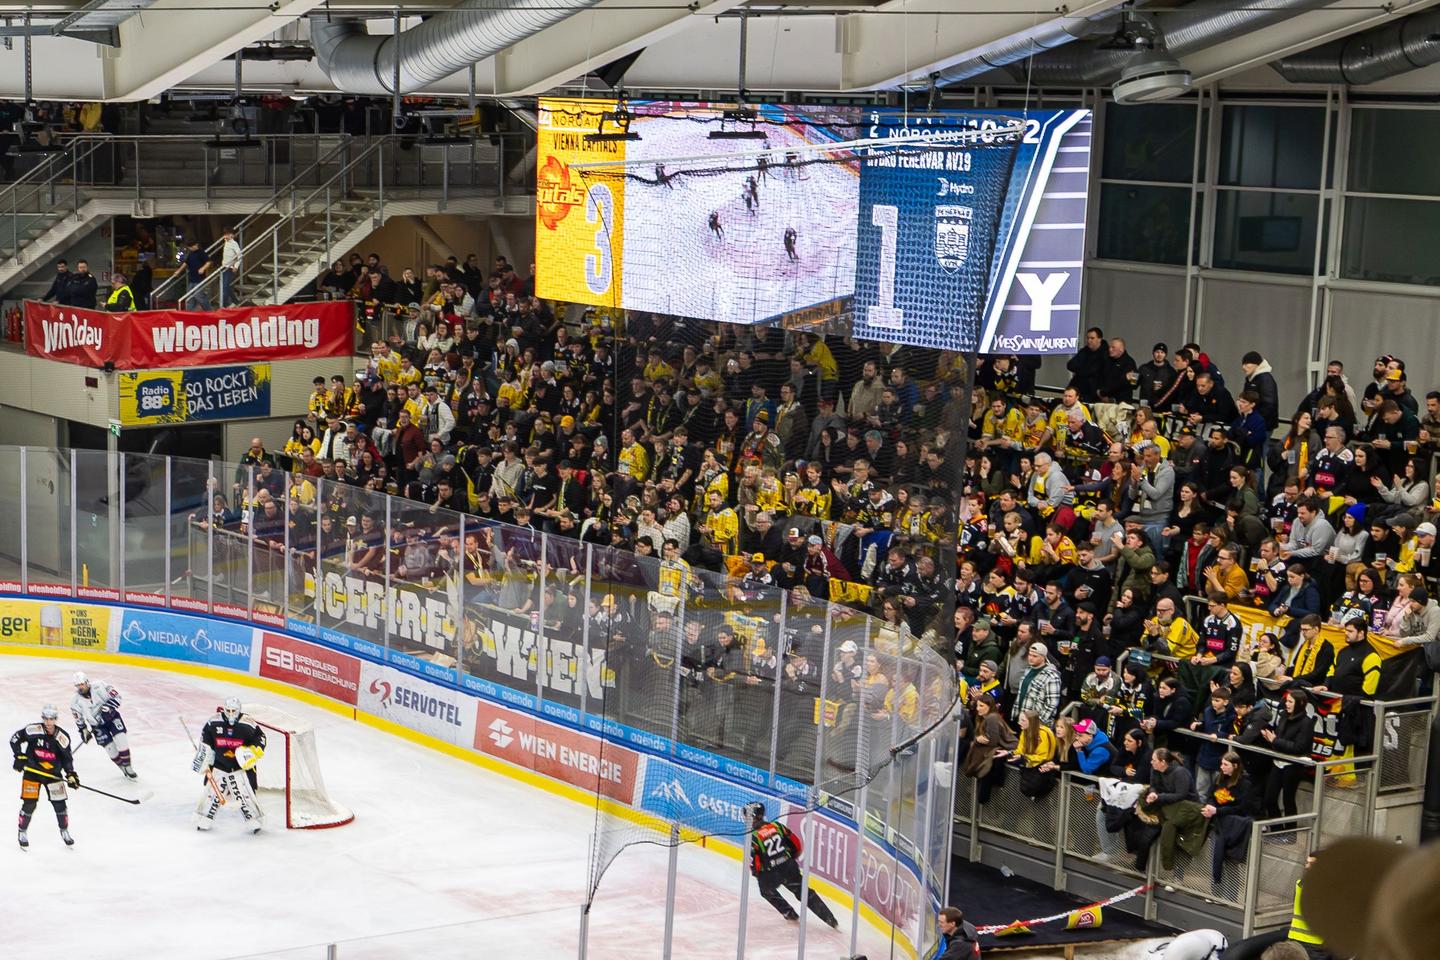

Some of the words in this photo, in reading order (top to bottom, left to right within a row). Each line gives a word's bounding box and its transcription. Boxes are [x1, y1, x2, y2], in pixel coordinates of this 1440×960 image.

[946, 152, 971, 171] AV19
[585, 183, 613, 294] 3
[867, 205, 903, 330] 1
[1016, 273, 1070, 331] Y
[142, 386, 169, 396] Radio
[186, 382, 202, 397] SO
[206, 371, 248, 393] ROCKT
[187, 395, 214, 414] DAS
[218, 386, 258, 408] LEBEN
[148, 630, 188, 646] NIEDAX
[213, 640, 250, 657] NIEDAX
[266, 647, 294, 671] SB
[295, 663, 311, 676] UND
[312, 669, 357, 691] BEDACHUNG
[394, 686, 462, 727] SERVOTEL
[518, 731, 556, 761] WIEN
[559, 744, 623, 784] ENERGIE
[763, 834, 785, 857] 22
